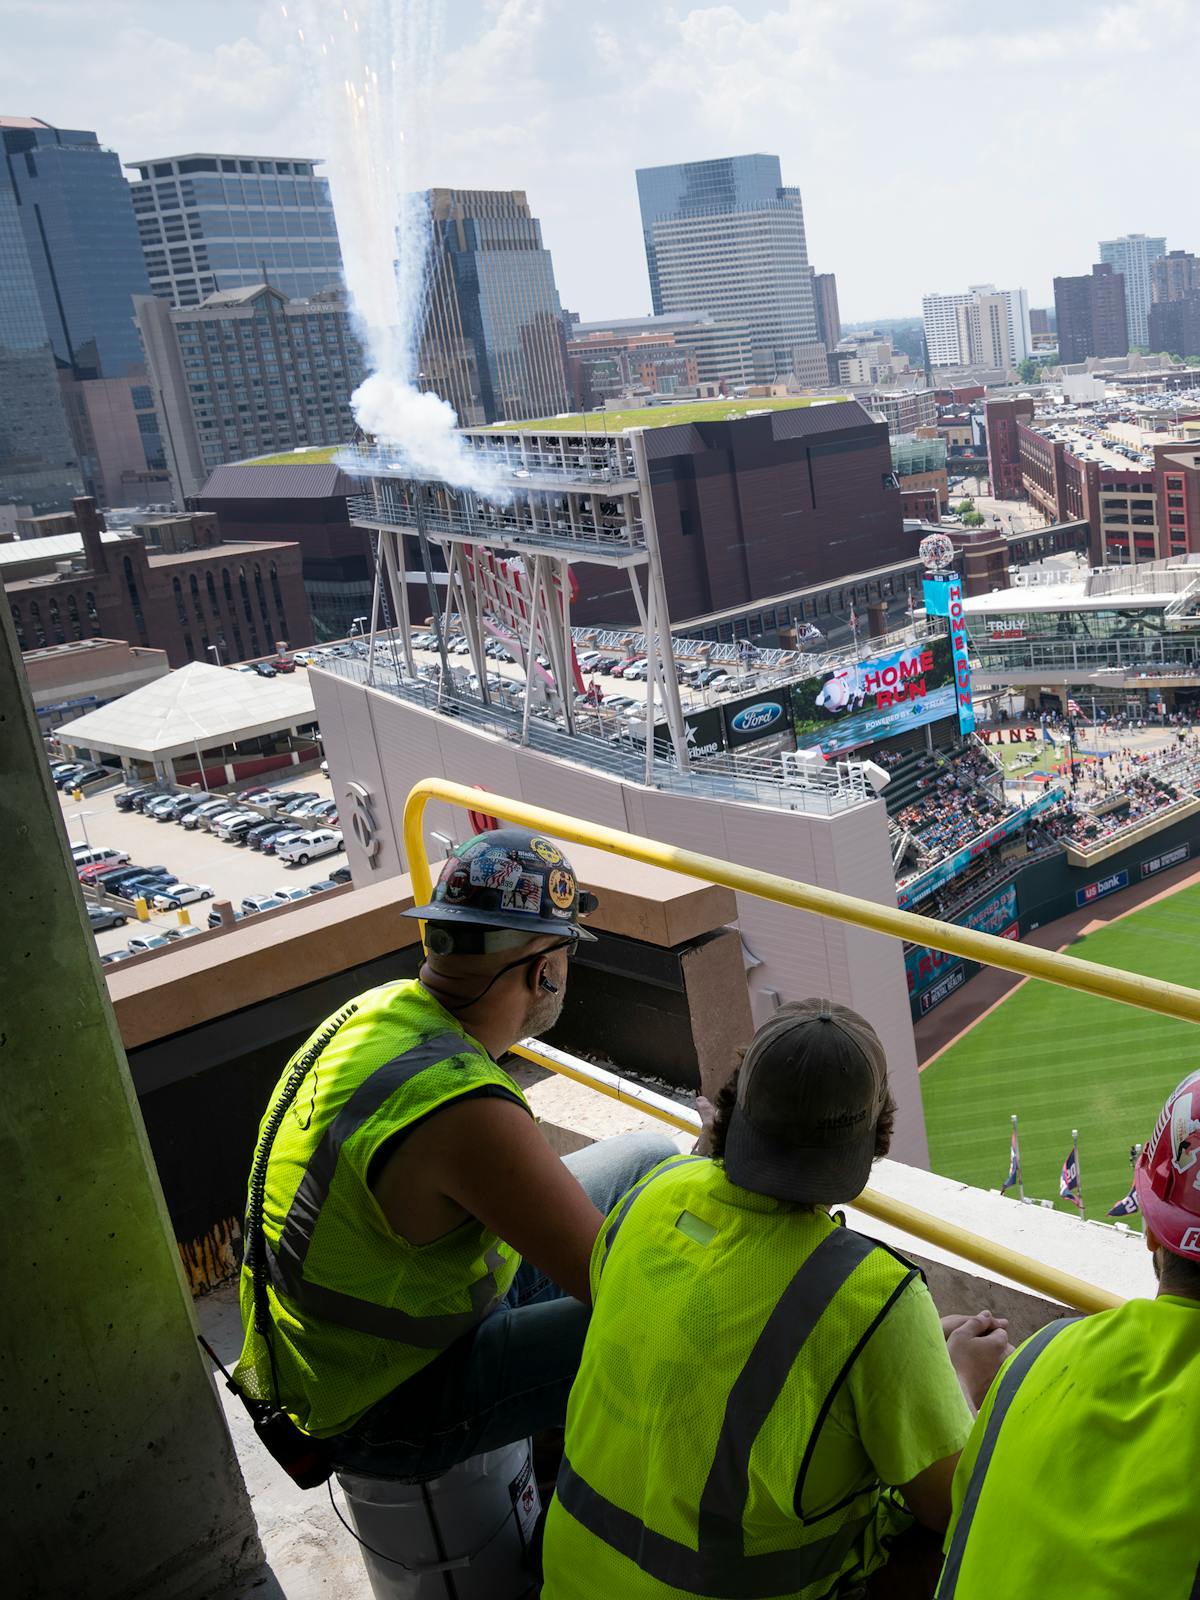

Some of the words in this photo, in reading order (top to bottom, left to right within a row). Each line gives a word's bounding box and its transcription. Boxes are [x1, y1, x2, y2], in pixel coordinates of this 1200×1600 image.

[950, 586, 965, 650] HOME
[987, 620, 1026, 631] TRULY
[865, 650, 934, 693] HOME
[957, 659, 971, 707] RUN
[876, 678, 927, 711] RUN
[742, 708, 772, 729] Ford
[864, 713, 900, 731] POWERED
[1097, 875, 1120, 893] bank
